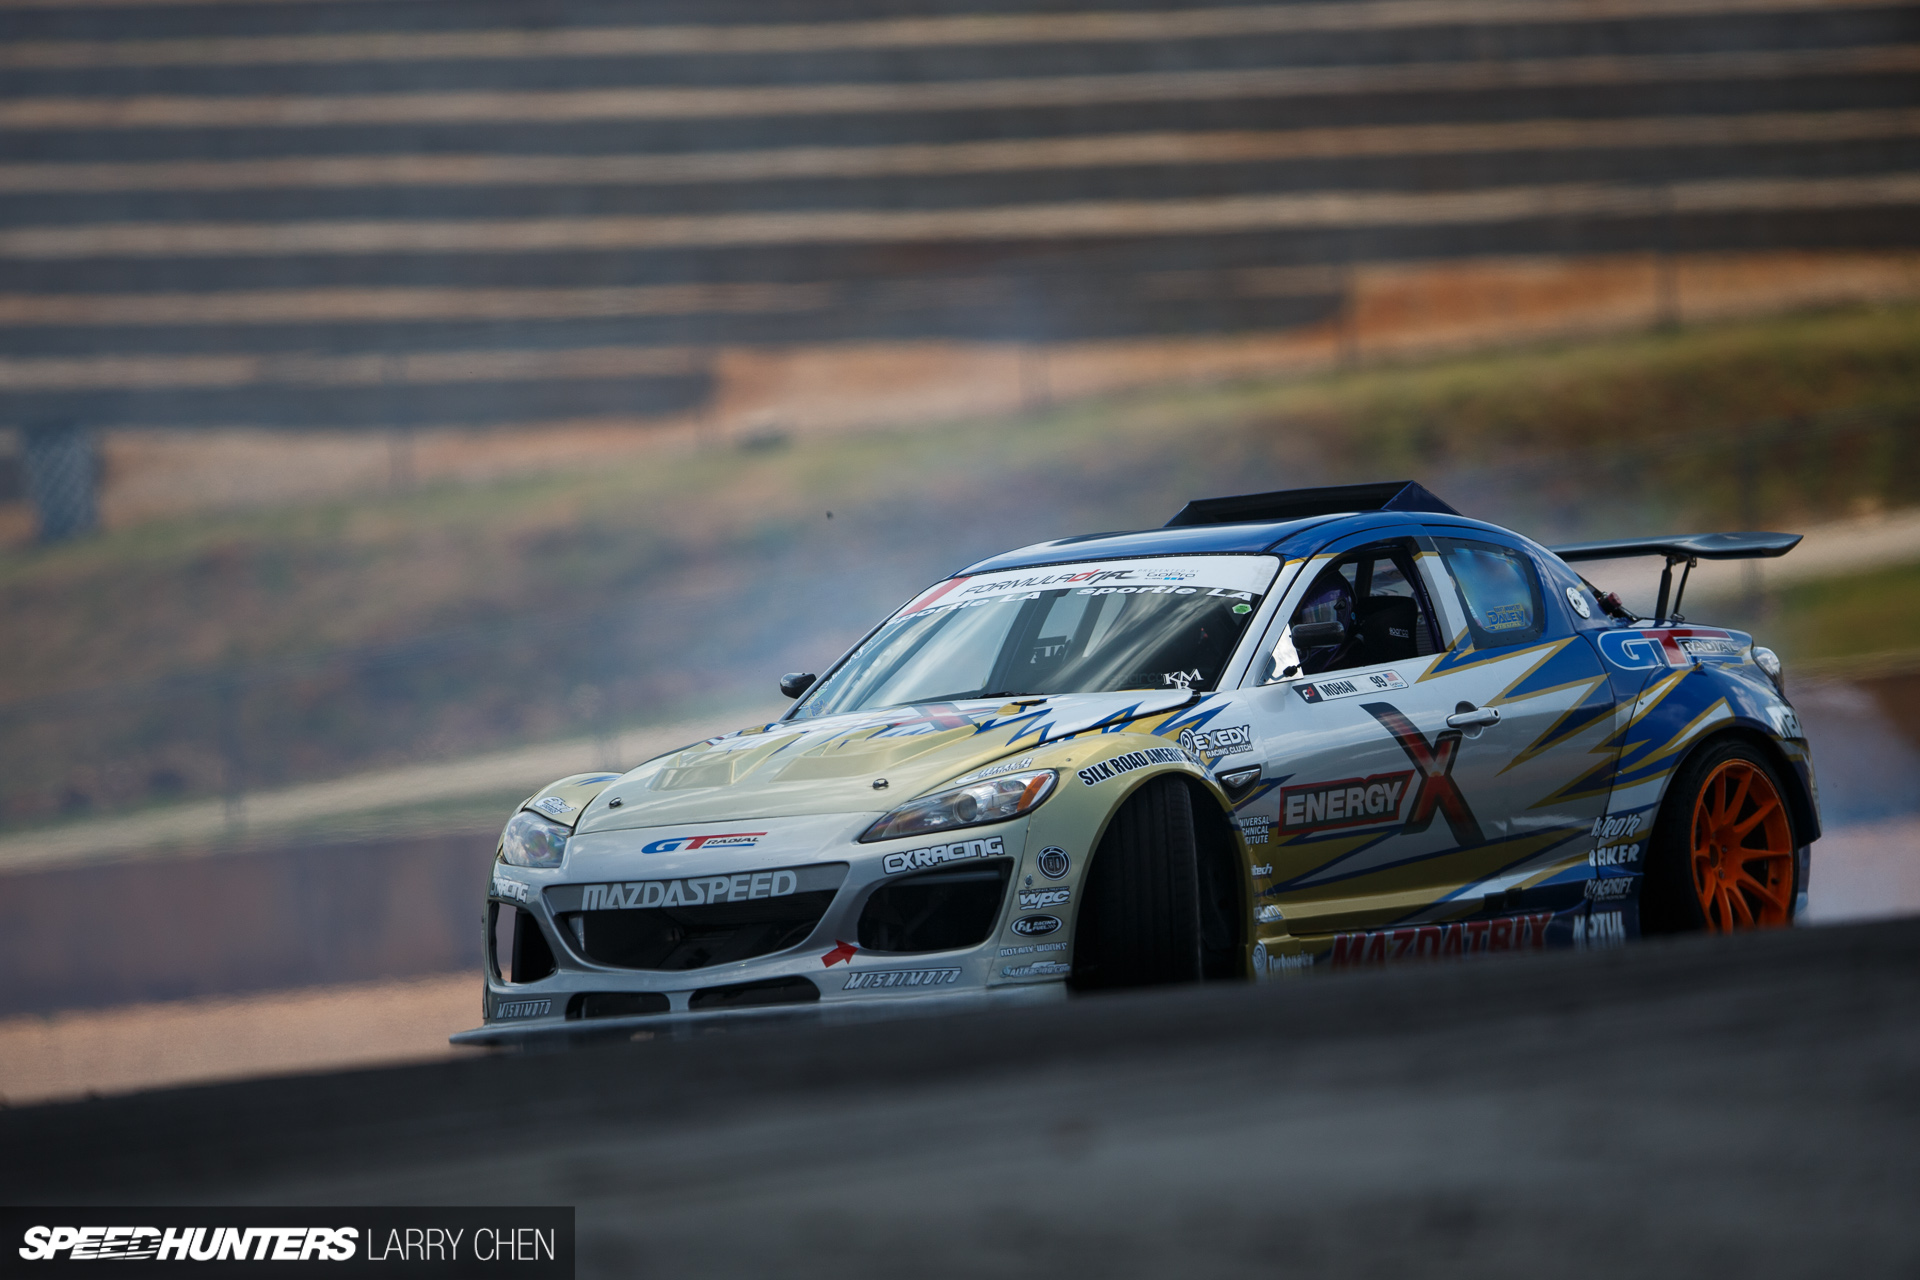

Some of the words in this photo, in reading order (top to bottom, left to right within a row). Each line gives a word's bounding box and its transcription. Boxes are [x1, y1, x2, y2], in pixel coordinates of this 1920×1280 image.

[999, 592, 1042, 604] LA
[1076, 585, 1198, 596] sportie
[1206, 588, 1253, 601] LA
[1680, 640, 1740, 653] RADIAL
[1319, 680, 1358, 697] MOHAN
[1370, 675, 1388, 688] 99
[1193, 725, 1251, 750] EXEDY
[1206, 748, 1229, 759] RACING
[1229, 744, 1253, 755] CLUTCH
[1078, 760, 1116, 786] SILK
[1111, 751, 1149, 774] ROAD
[1286, 780, 1403, 826] ENERGY
[1239, 815, 1270, 827] NIVERSAL
[706, 837, 759, 845] RADIAL
[883, 836, 1005, 875] CXRACING
[581, 869, 798, 911] MAZDASPEED
[842, 967, 962, 990] MISHIMOTO
